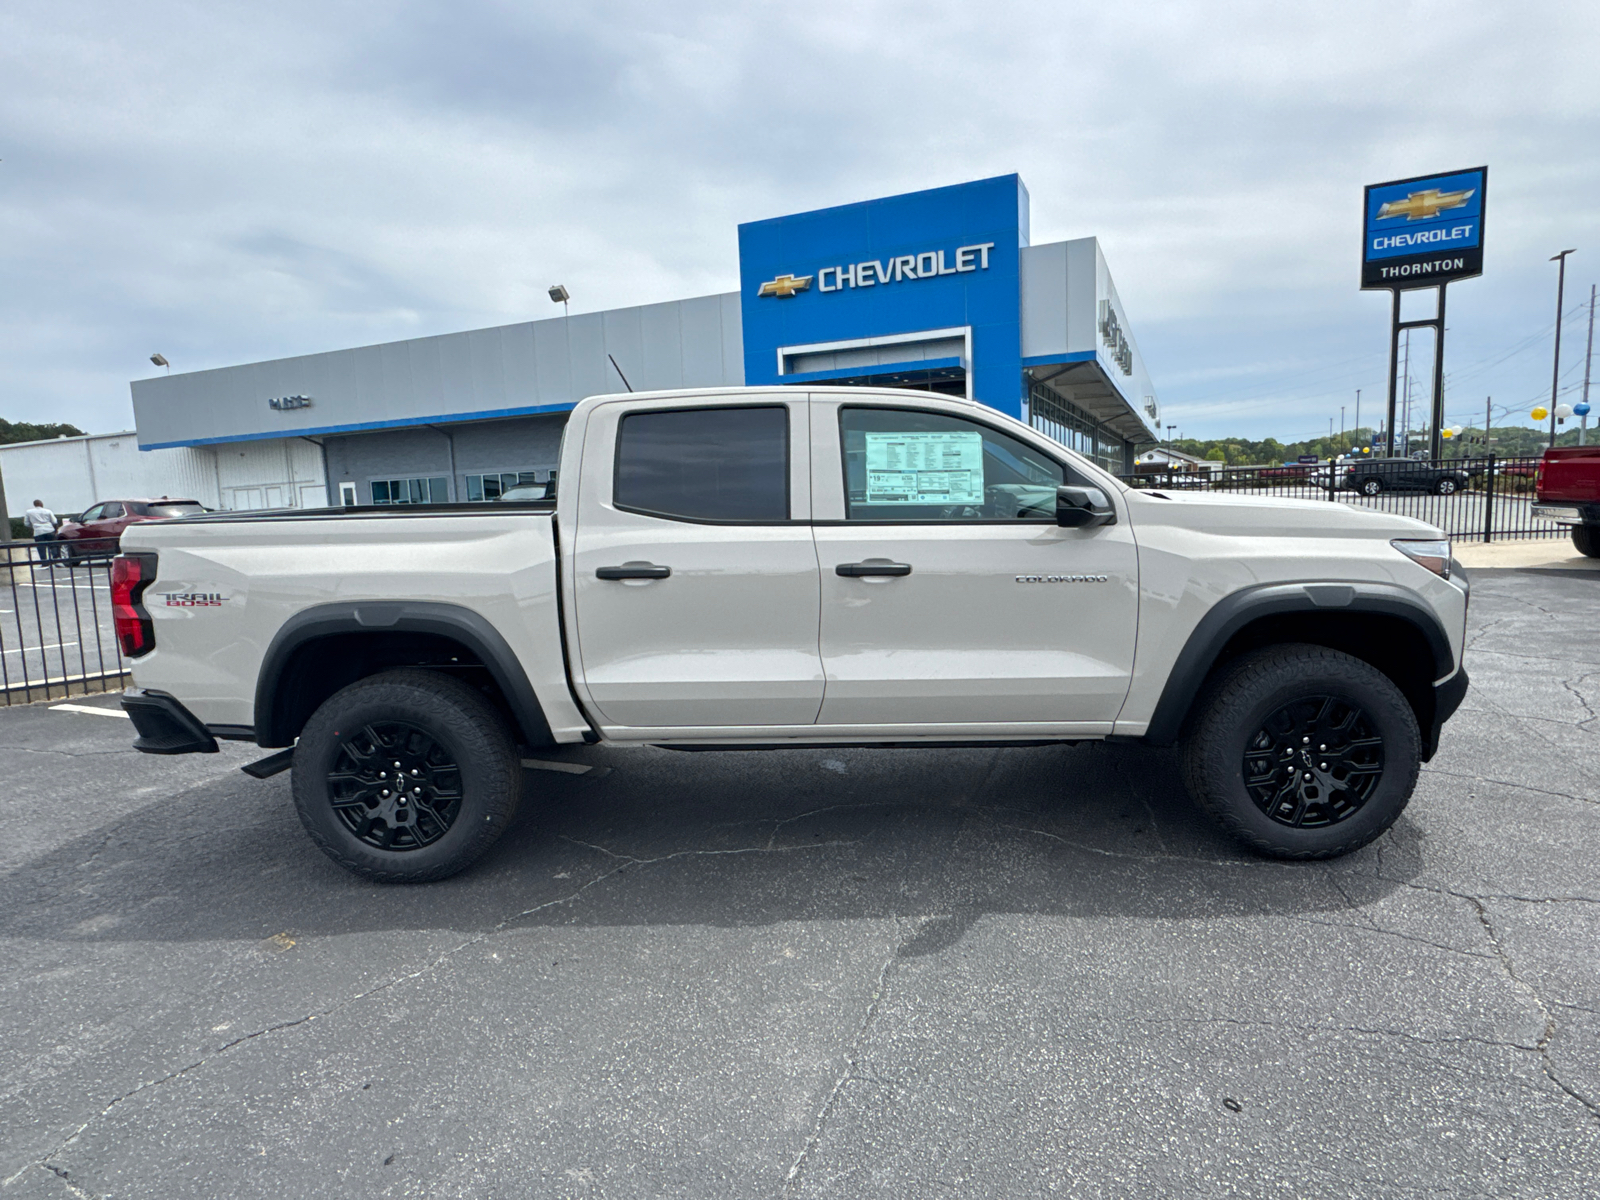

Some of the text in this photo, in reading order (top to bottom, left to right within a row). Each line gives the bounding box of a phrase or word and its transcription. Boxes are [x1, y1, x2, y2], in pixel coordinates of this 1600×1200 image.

[1373, 225, 1473, 250] CHEVROLET
[818, 242, 995, 293] CHEVROLET
[1381, 258, 1464, 278] THORNTON
[1015, 575, 1108, 584] COLORADO
[156, 593, 230, 601] TRAIL
